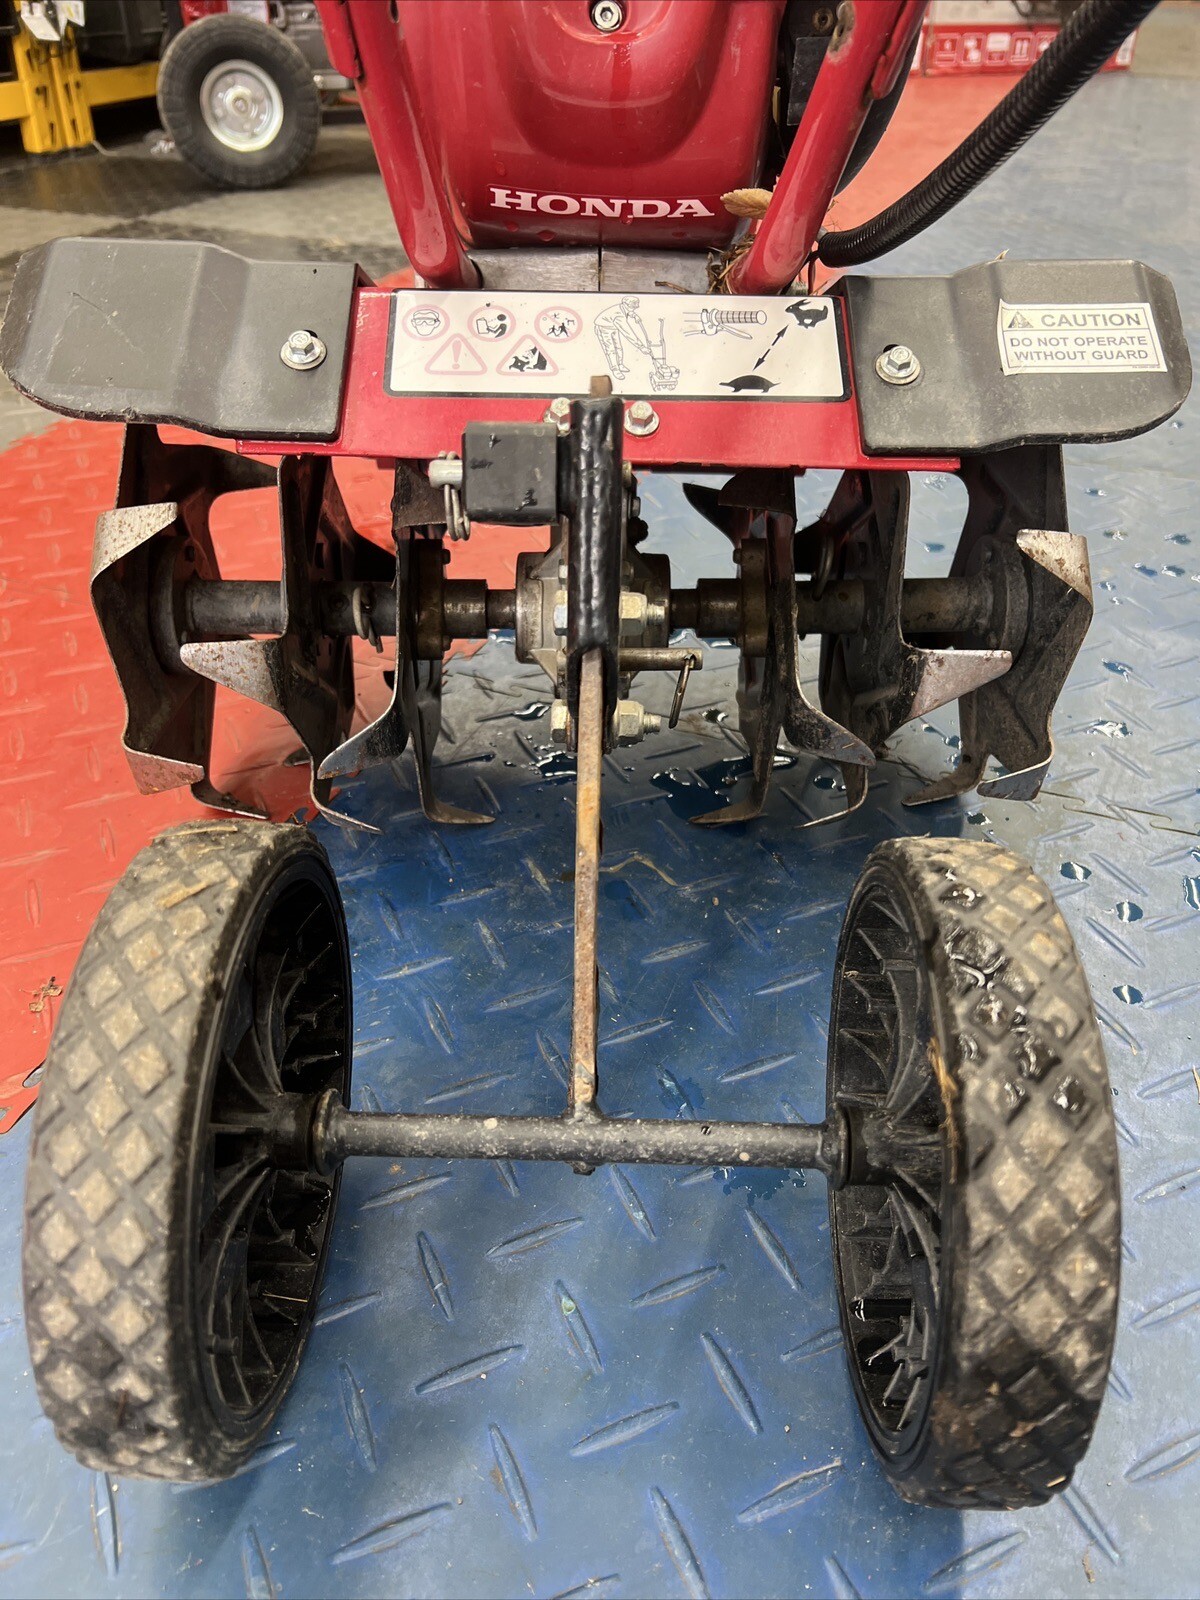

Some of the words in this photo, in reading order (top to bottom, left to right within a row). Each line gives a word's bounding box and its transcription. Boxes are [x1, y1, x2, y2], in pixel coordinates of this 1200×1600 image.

[489, 187, 715, 219] HONDA
[1040, 313, 1141, 327] CAUTION
[1010, 337, 1033, 347] DO
[1037, 336, 1069, 347] NOT
[1074, 336, 1148, 346] OPERATE
[1014, 350, 1087, 361] WITHOUT
[1092, 349, 1148, 360] GUARD
